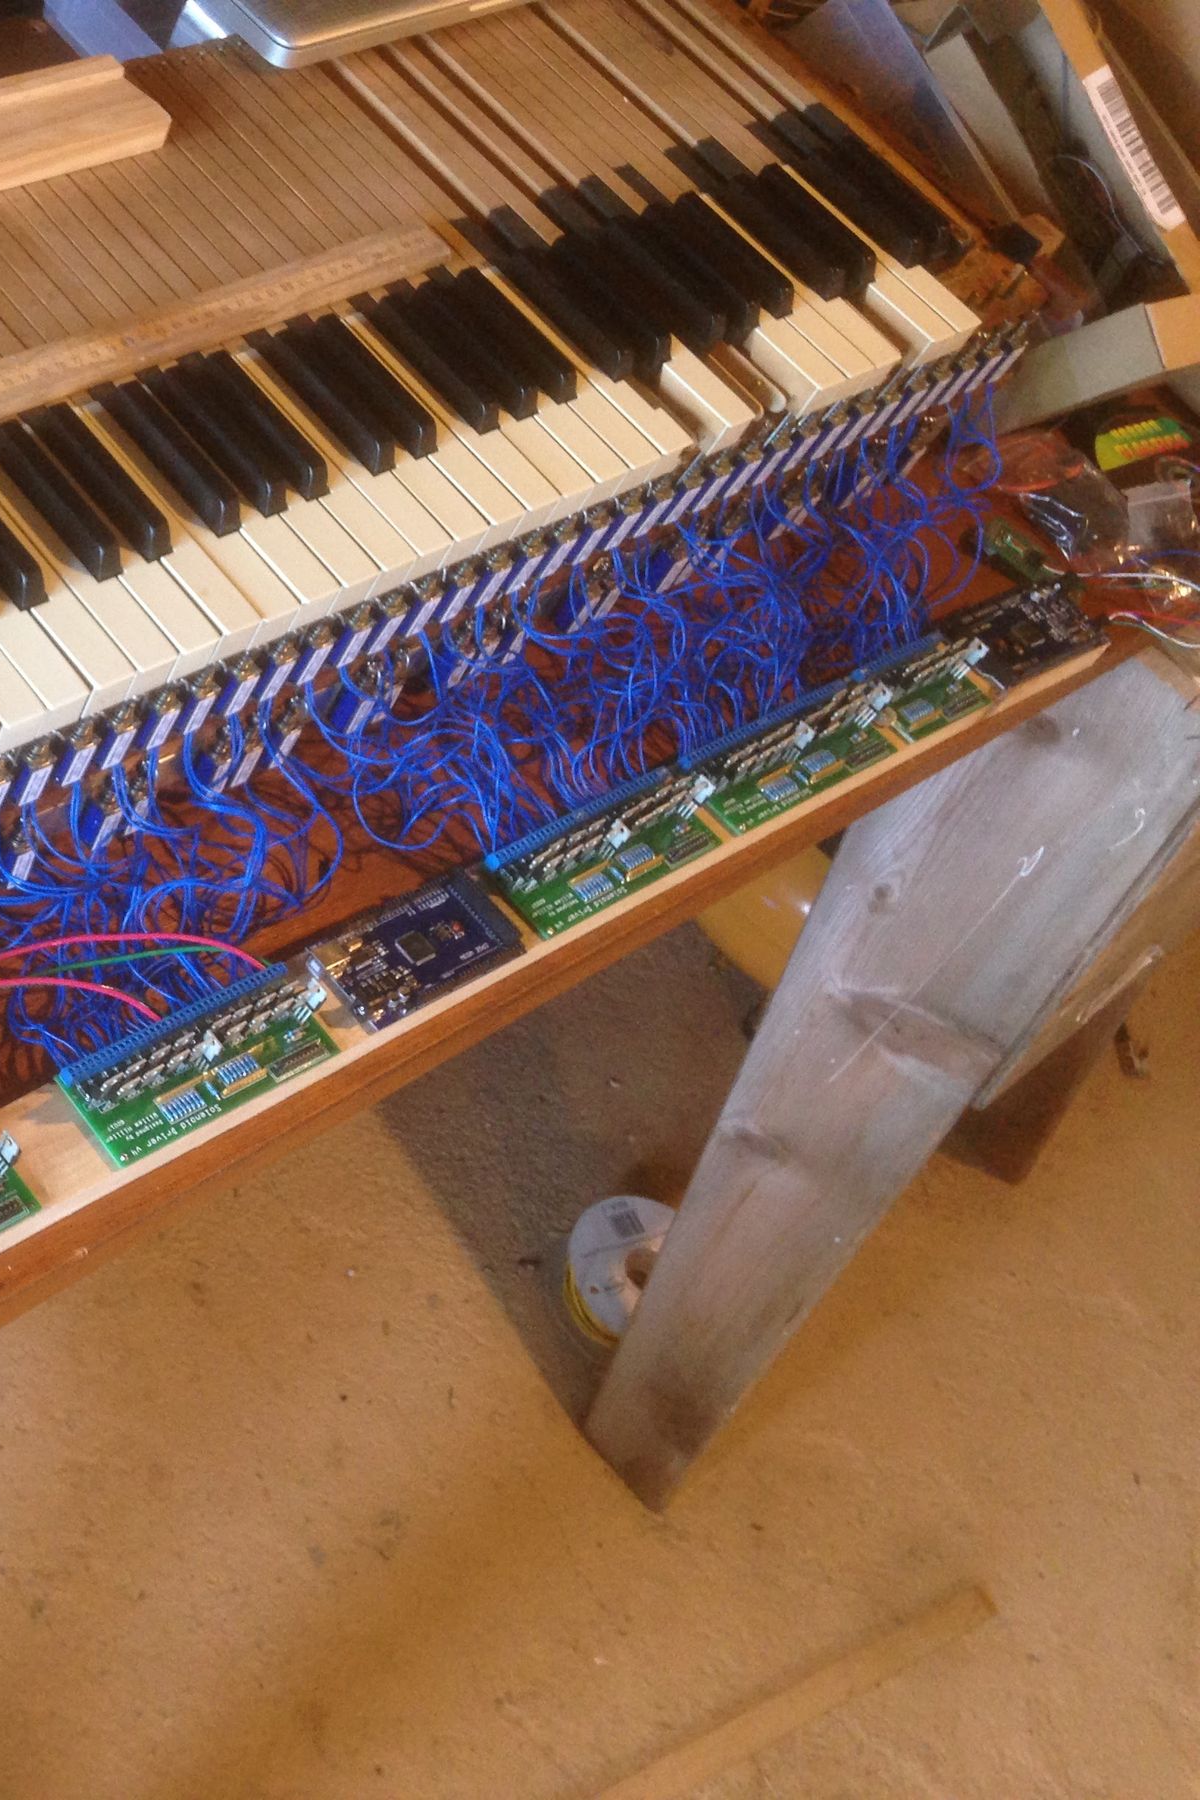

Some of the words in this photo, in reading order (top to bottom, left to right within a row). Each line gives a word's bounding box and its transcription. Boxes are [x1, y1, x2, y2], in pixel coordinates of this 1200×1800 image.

[180, 1104, 222, 1130] Solenoid
[147, 1127, 178, 1147] Driver
[131, 1146, 142, 1155] v4
